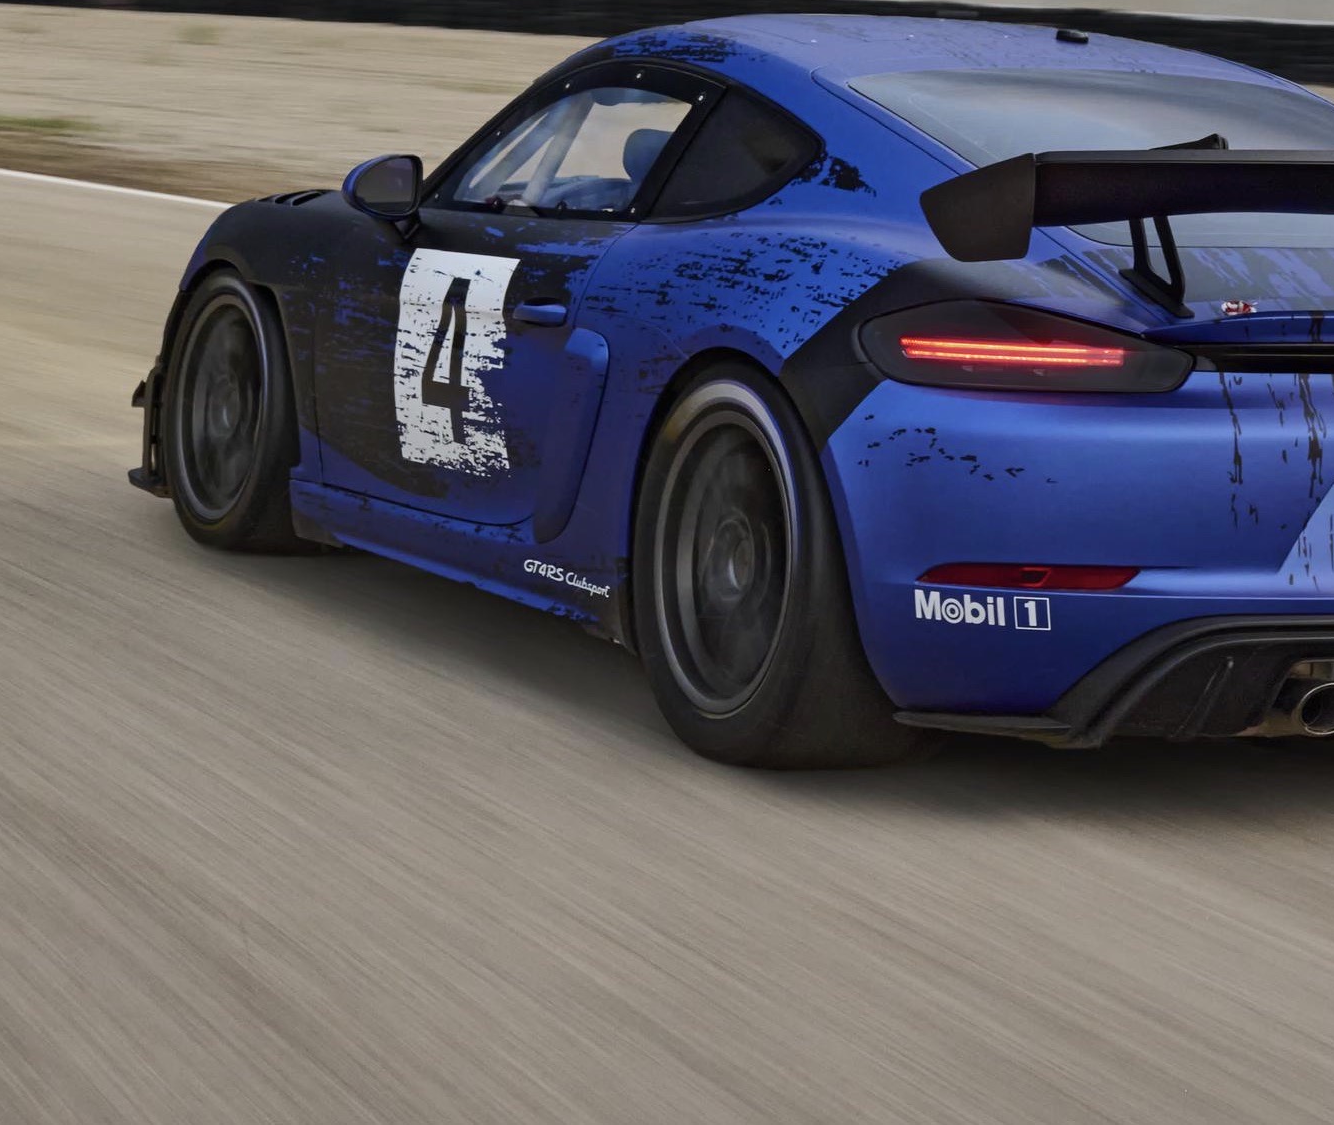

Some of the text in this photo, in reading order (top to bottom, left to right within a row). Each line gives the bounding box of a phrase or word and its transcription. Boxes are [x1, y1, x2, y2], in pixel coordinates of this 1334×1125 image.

[422, 276, 471, 447] 4
[565, 572, 611, 598] Clubsport
[914, 589, 1038, 627] Mobil 1
